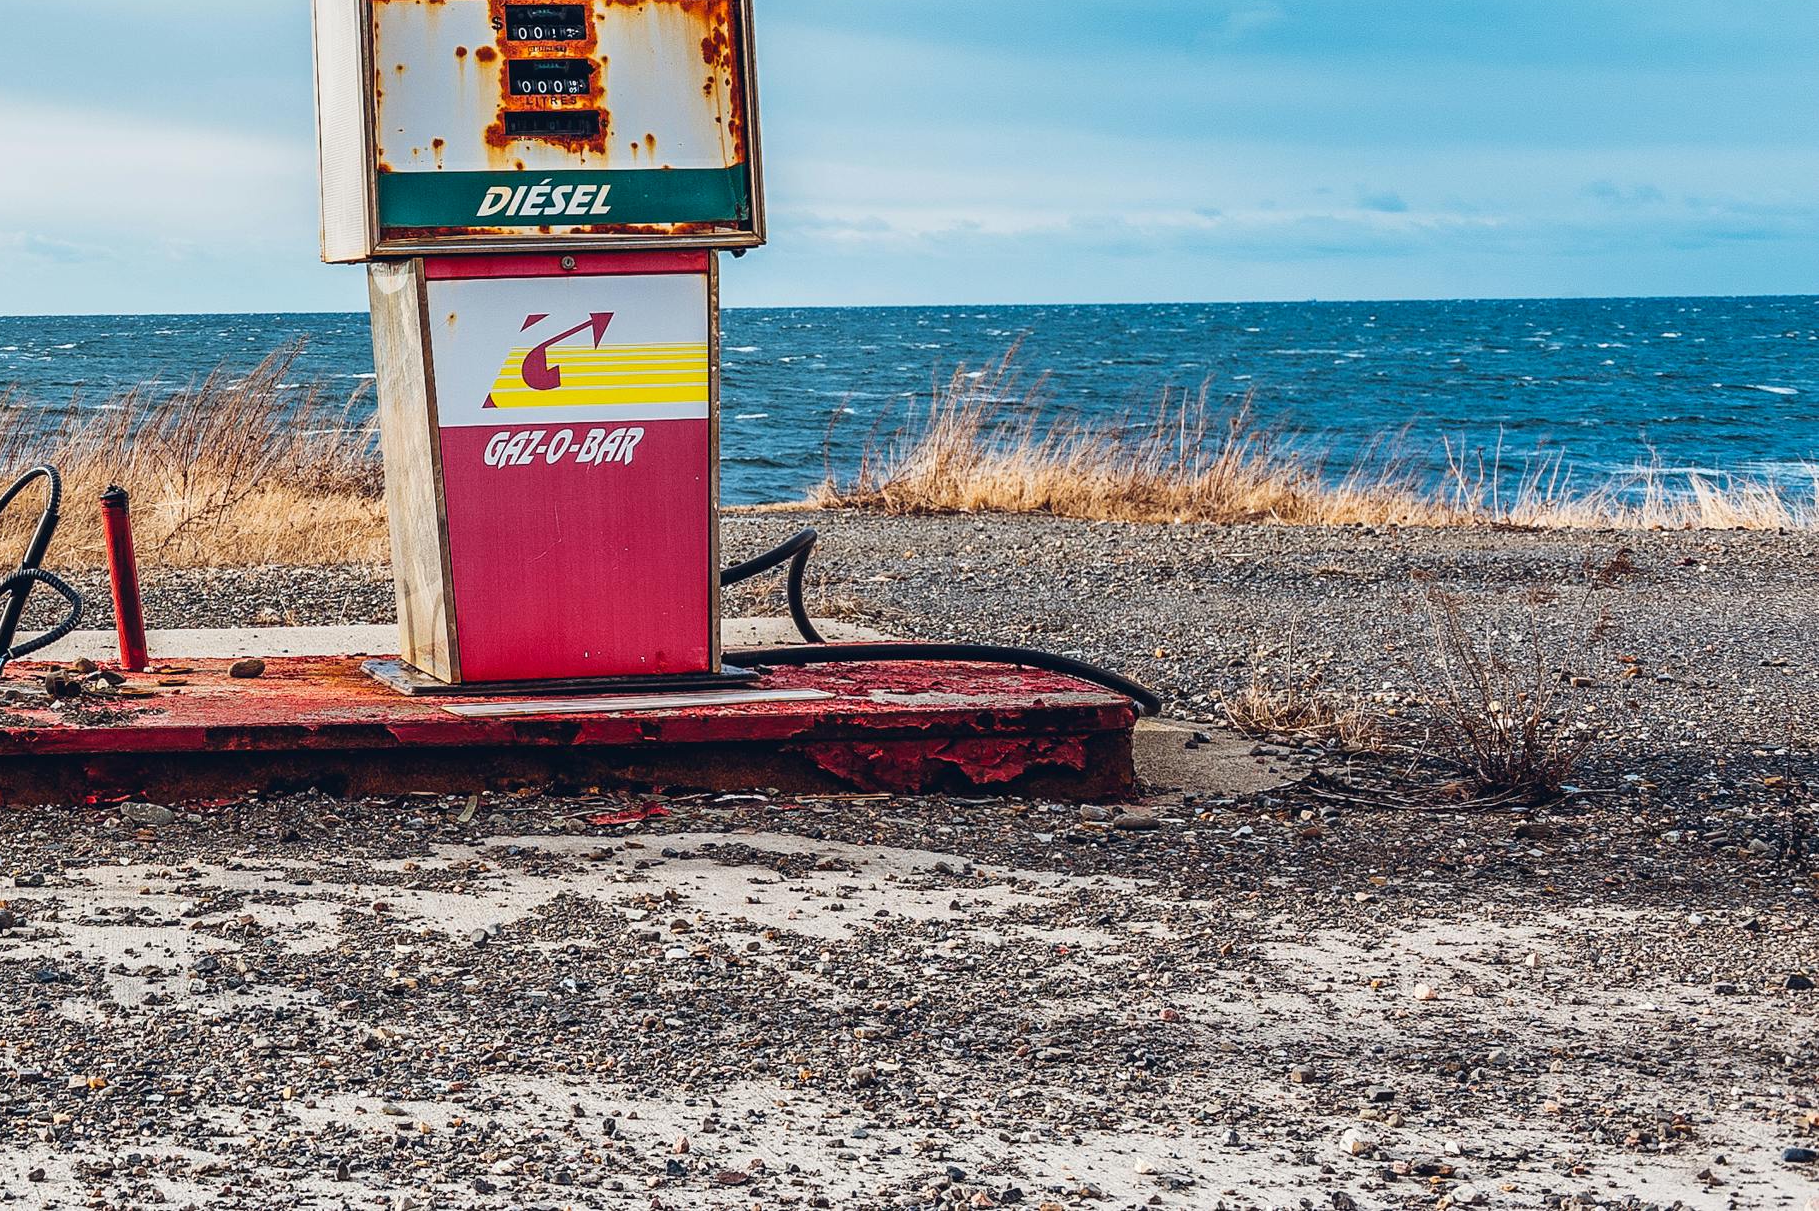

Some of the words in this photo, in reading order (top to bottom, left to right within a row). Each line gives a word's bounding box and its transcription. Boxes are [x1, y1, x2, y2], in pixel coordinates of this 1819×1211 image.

[526, 96, 577, 105] LITRES
[476, 178, 612, 217] DIÉSEL
[483, 427, 644, 469] GAZ-O-BAR
